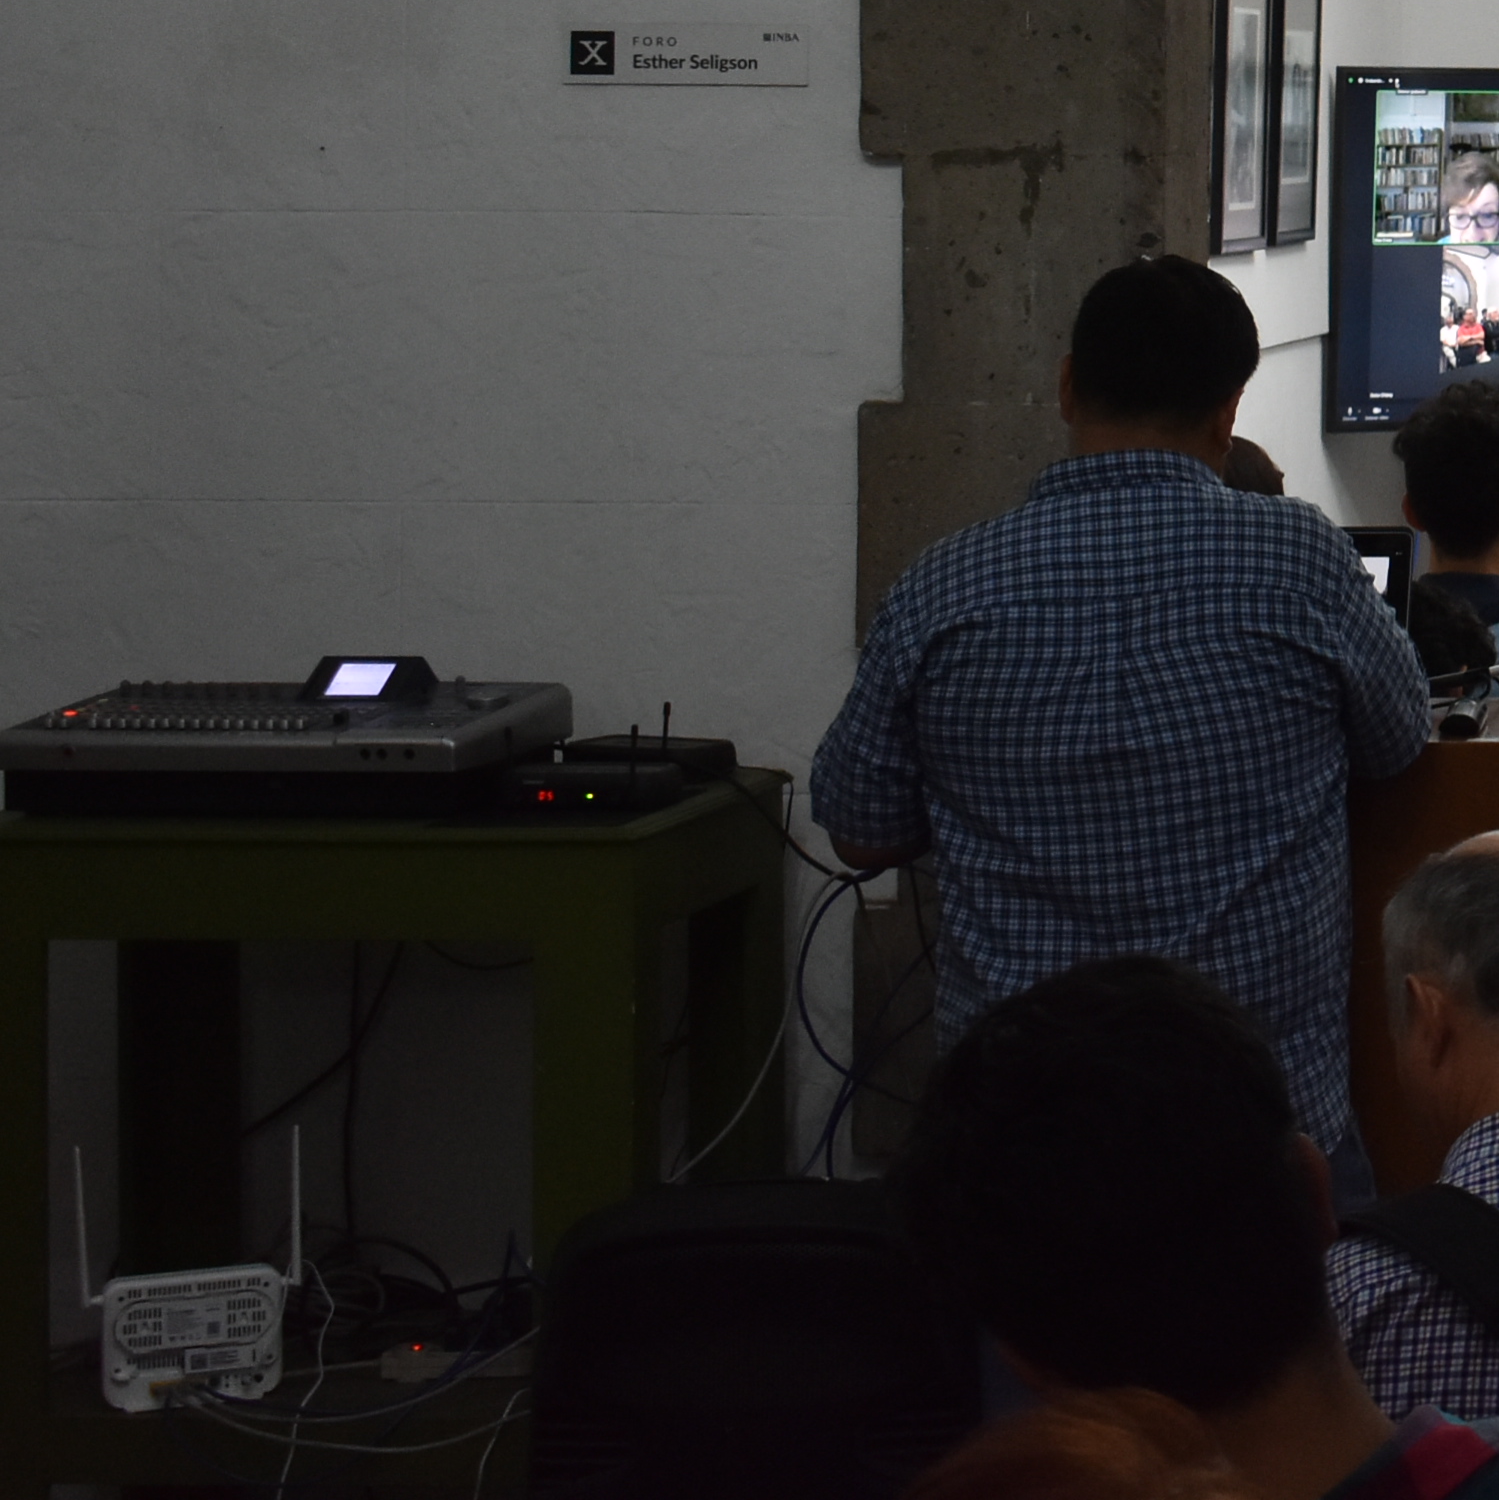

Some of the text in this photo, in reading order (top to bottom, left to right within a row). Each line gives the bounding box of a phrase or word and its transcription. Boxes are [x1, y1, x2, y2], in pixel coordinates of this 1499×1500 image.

[632, 36, 678, 47] FORO
[578, 40, 608, 66] X
[632, 54, 758, 73] Esther Seligson
